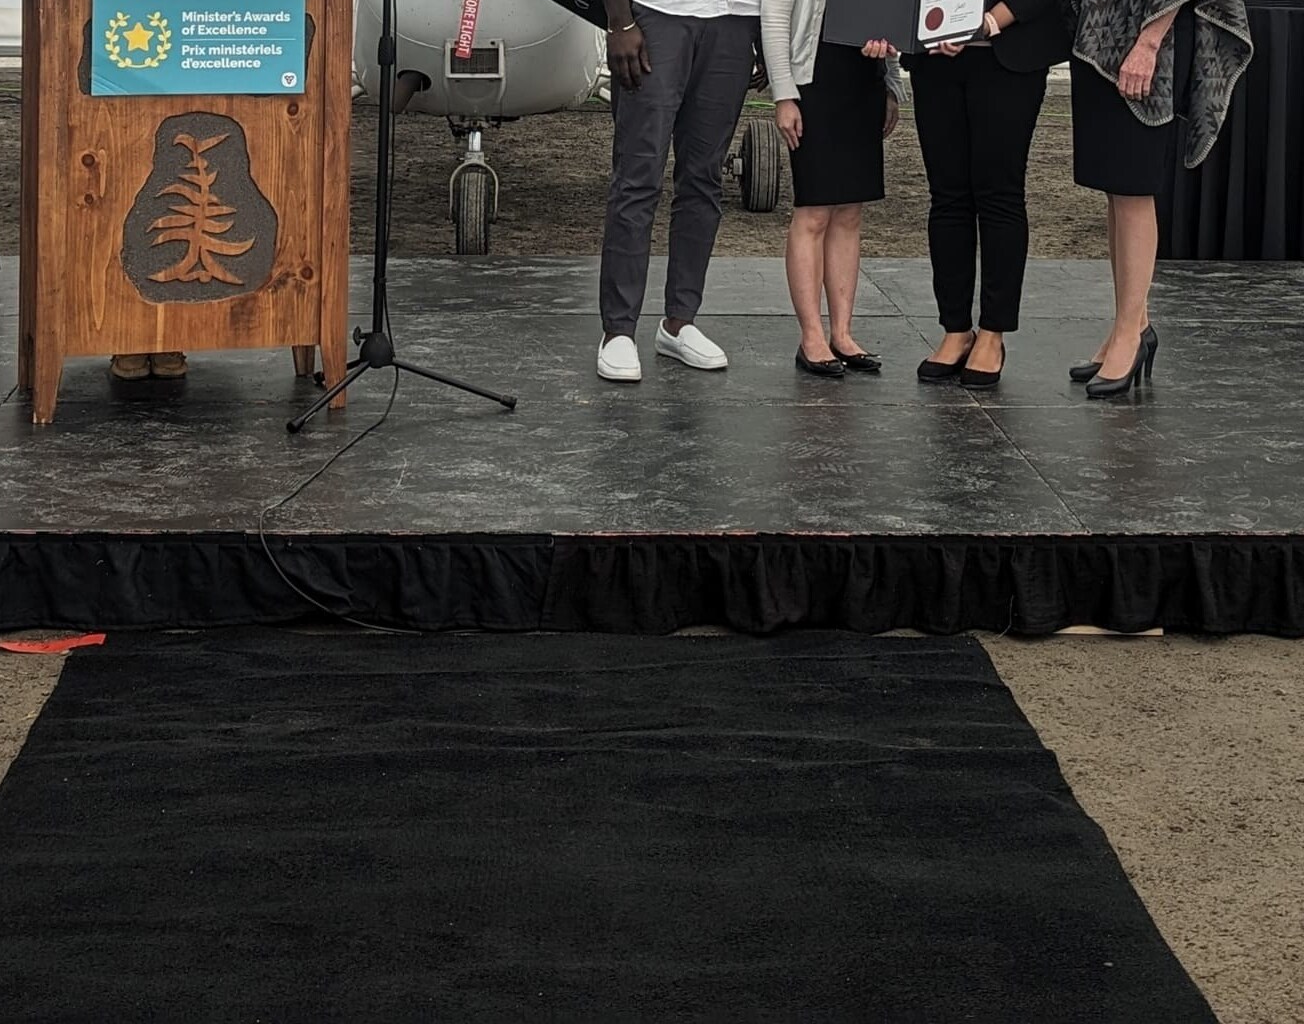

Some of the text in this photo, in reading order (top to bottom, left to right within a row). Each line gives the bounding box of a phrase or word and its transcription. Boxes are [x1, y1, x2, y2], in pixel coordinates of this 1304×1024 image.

[243, 10, 291, 22] Awards
[181, 24, 268, 36] of Excellence
[458, 19, 474, 54] FLIGHT
[181, 43, 283, 56] Prix ministériels
